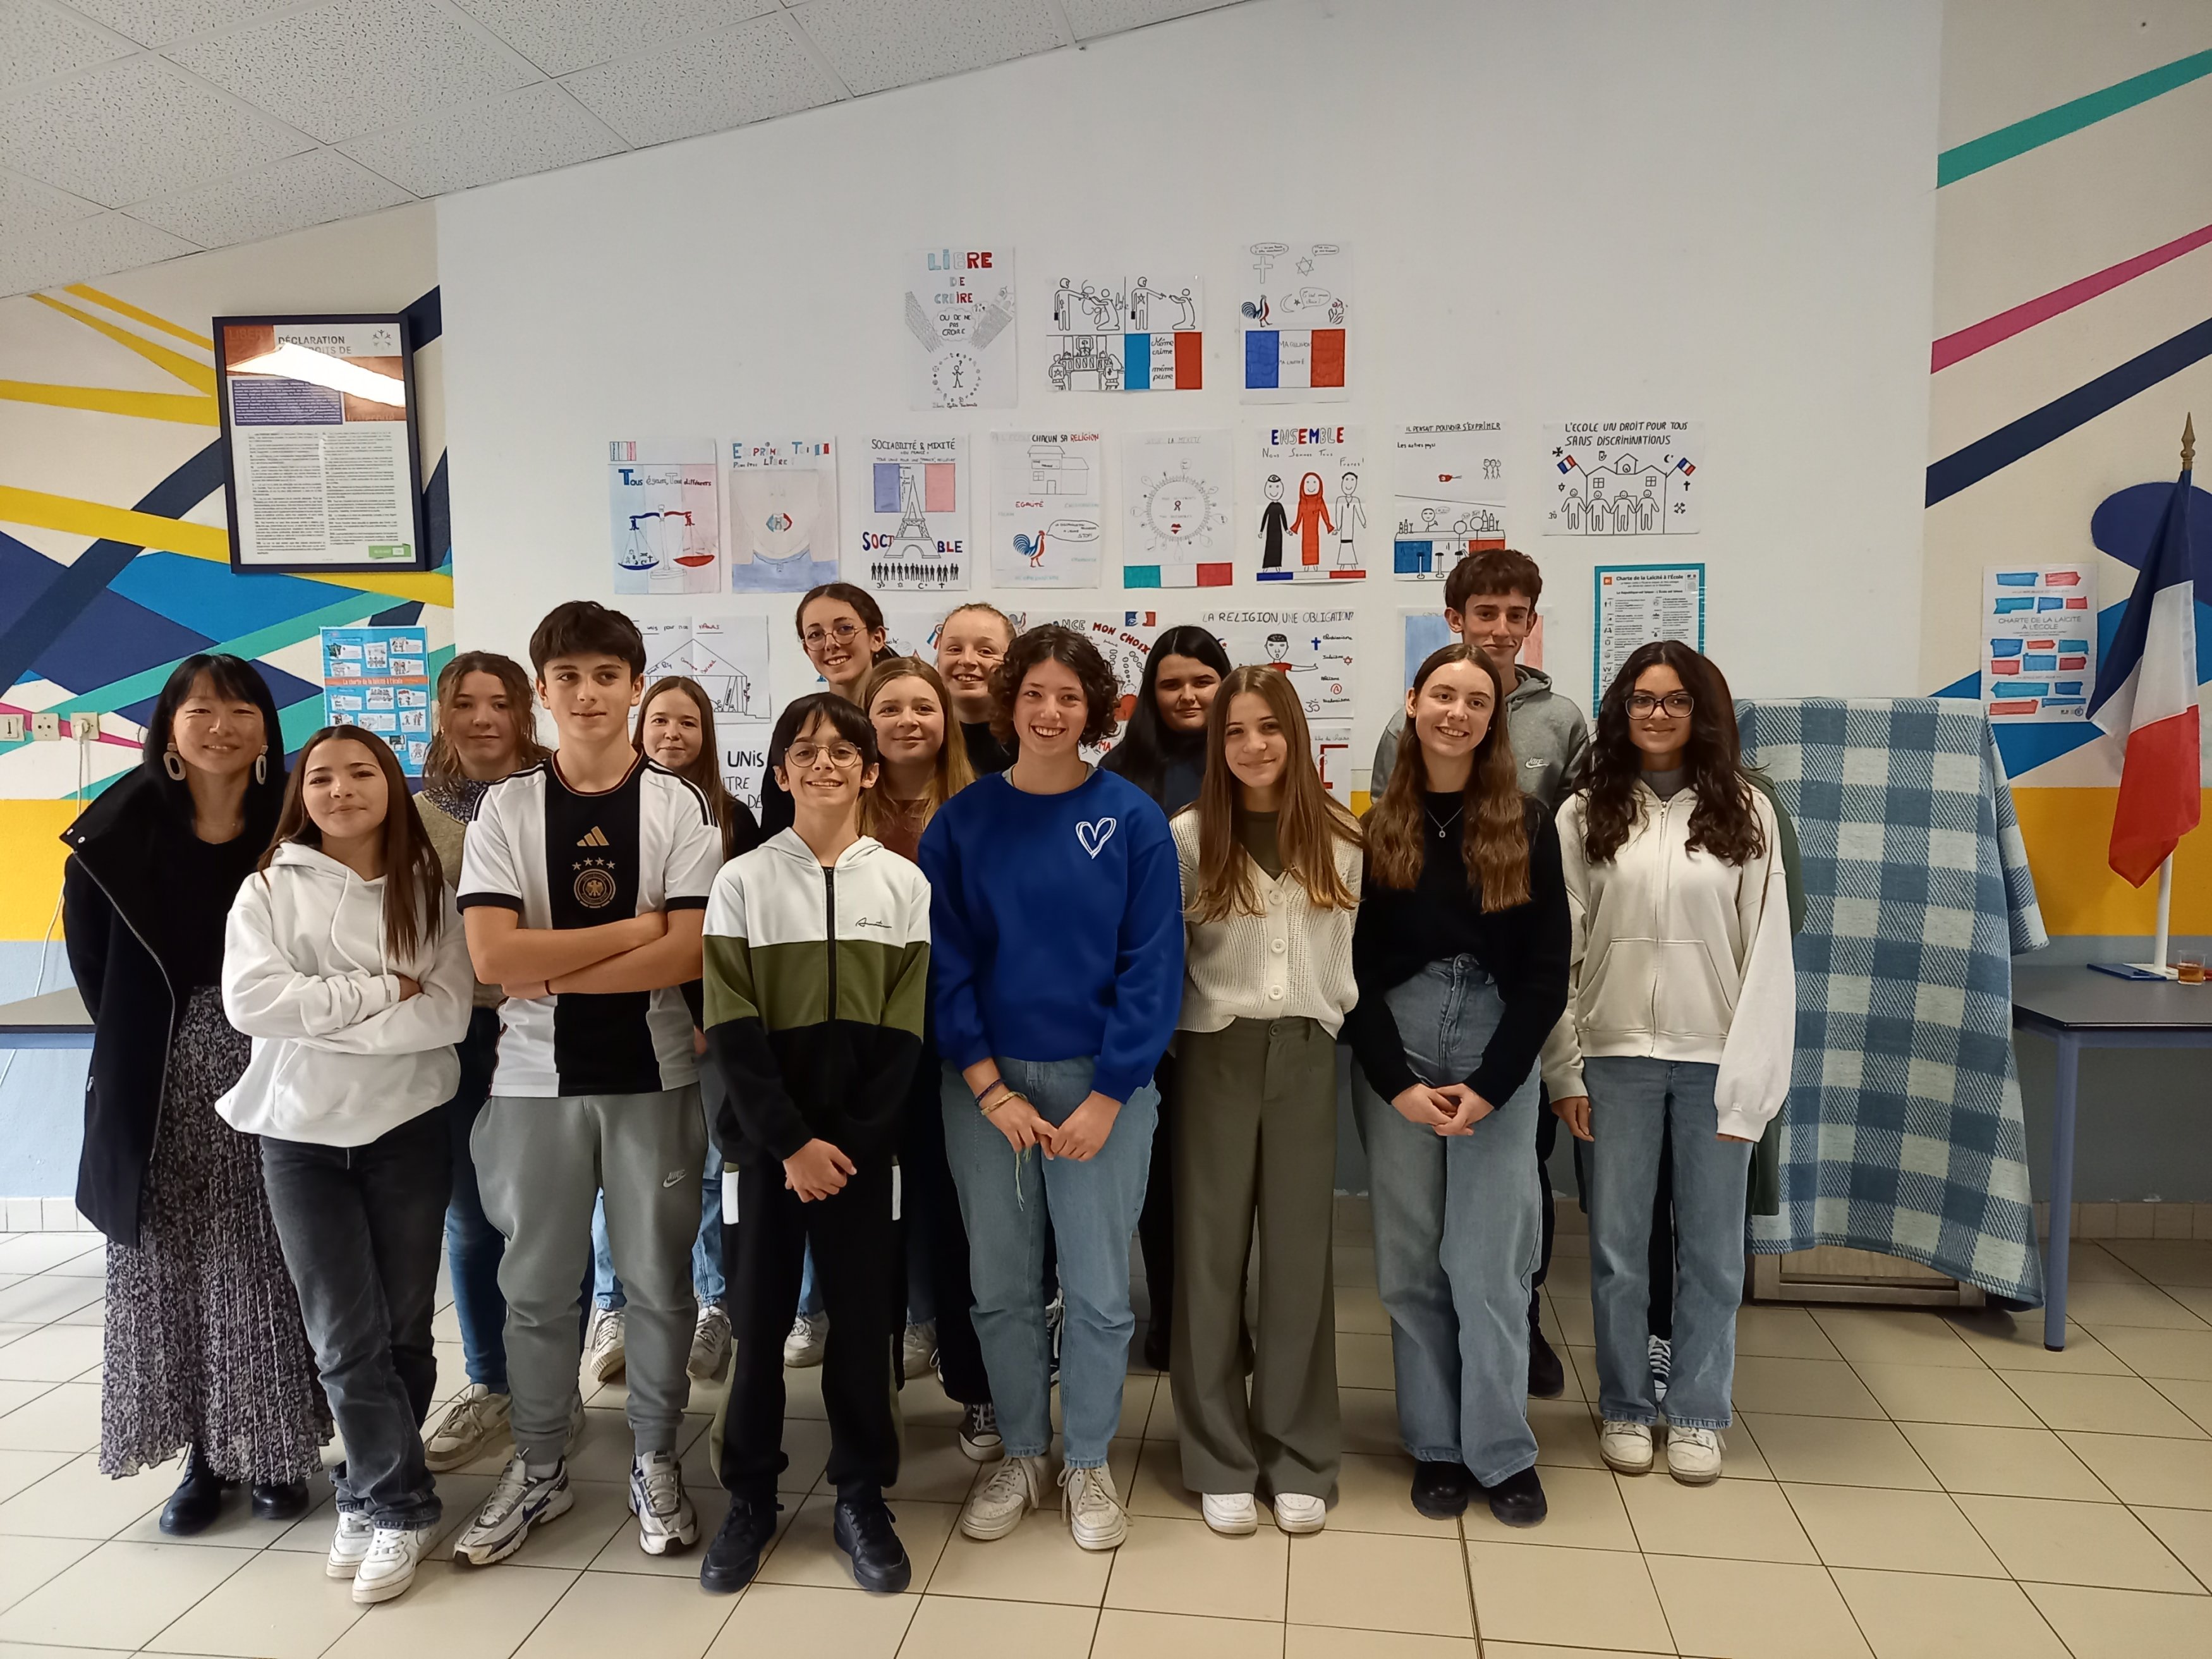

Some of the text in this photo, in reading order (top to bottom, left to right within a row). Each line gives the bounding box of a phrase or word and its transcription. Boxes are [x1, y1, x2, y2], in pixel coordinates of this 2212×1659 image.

[928, 249, 992, 270] LIBRE
[950, 277, 966, 287] DE
[278, 335, 345, 344] DÉCLARATION
[339, 346, 351, 354] DE
[1152, 364, 1174, 372] même
[1153, 373, 1174, 382] peine
[1436, 423, 1461, 432] POUVOIR
[1463, 421, 1500, 431] S'EXPRIMER
[1565, 421, 1688, 432] L'ECOLE UN DROIT POUR TOUS
[1032, 434, 1057, 442] CHACUN
[1071, 432, 1099, 442] RELIGION
[1272, 427, 1344, 446] ENSEMBLE
[1565, 435, 1671, 446] SANS DISCRIMINATIONS
[872, 438, 956, 450] SOCIABILITÉ & MIXITÉ
[1263, 447, 1280, 458] Nous
[1319, 449, 1333, 457] Tous
[618, 469, 643, 485] Tous
[1203, 613, 1214, 622] LA
[1282, 612, 1298, 624] UNE
[1303, 611, 1354, 624] OBLIGATION?
[1092, 622, 1117, 636] MON
[1120, 633, 1151, 655] CHOIX
[727, 750, 764, 767] UNIS
